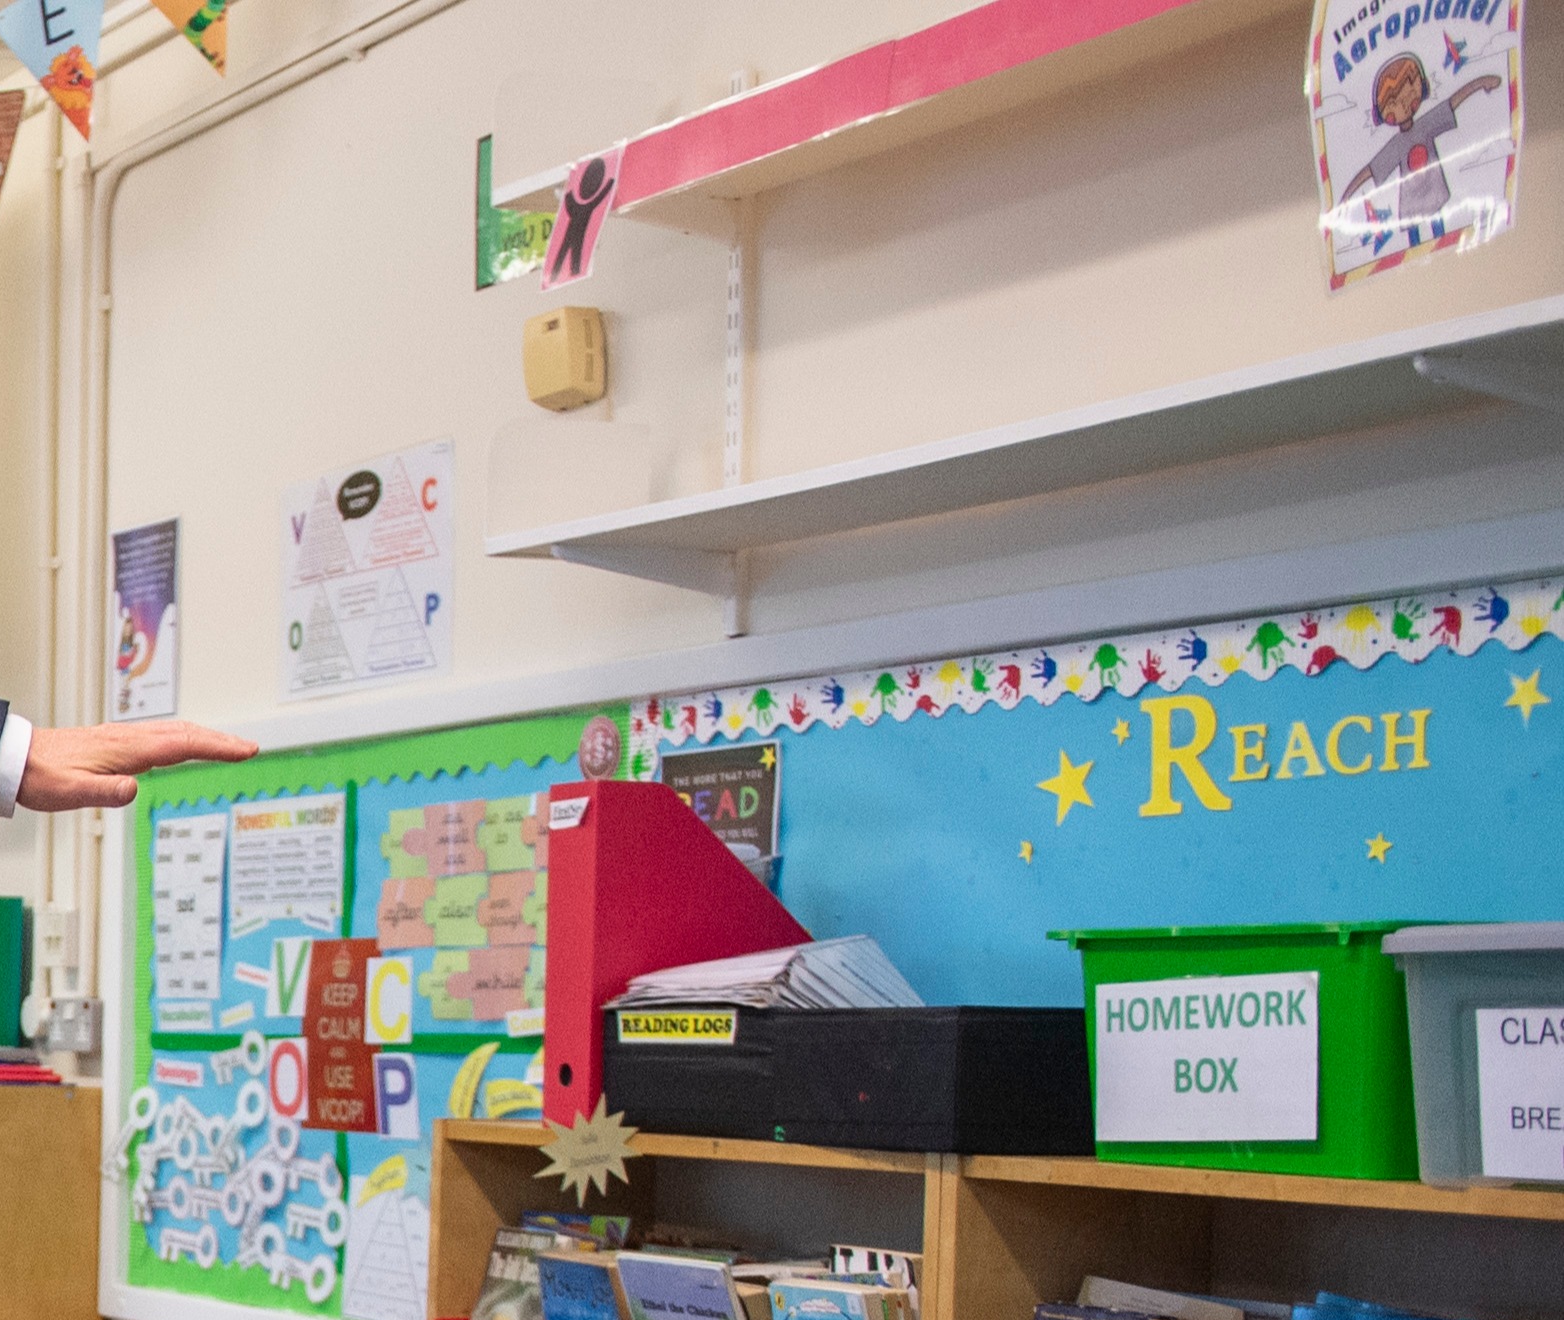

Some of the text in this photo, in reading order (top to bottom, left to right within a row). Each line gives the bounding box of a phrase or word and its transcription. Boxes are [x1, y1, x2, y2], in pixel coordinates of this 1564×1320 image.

[422, 477, 437, 511] C
[425, 592, 440, 625] P
[1139, 694, 1432, 817] REACH
[275, 940, 410, 1041] V C
[322, 983, 358, 1007] KEEP
[622, 1018, 732, 1033] READING LOGS
[1106, 989, 1307, 1032] HOMEWORK
[316, 1016, 362, 1041] CALM
[270, 1041, 413, 1135] O P
[324, 1065, 354, 1089] USE
[1174, 1058, 1239, 1093] BOX
[1512, 1106, 1564, 1131] BRE
[669, 1302, 685, 1314] the
[687, 1304, 728, 1320] Chicken
